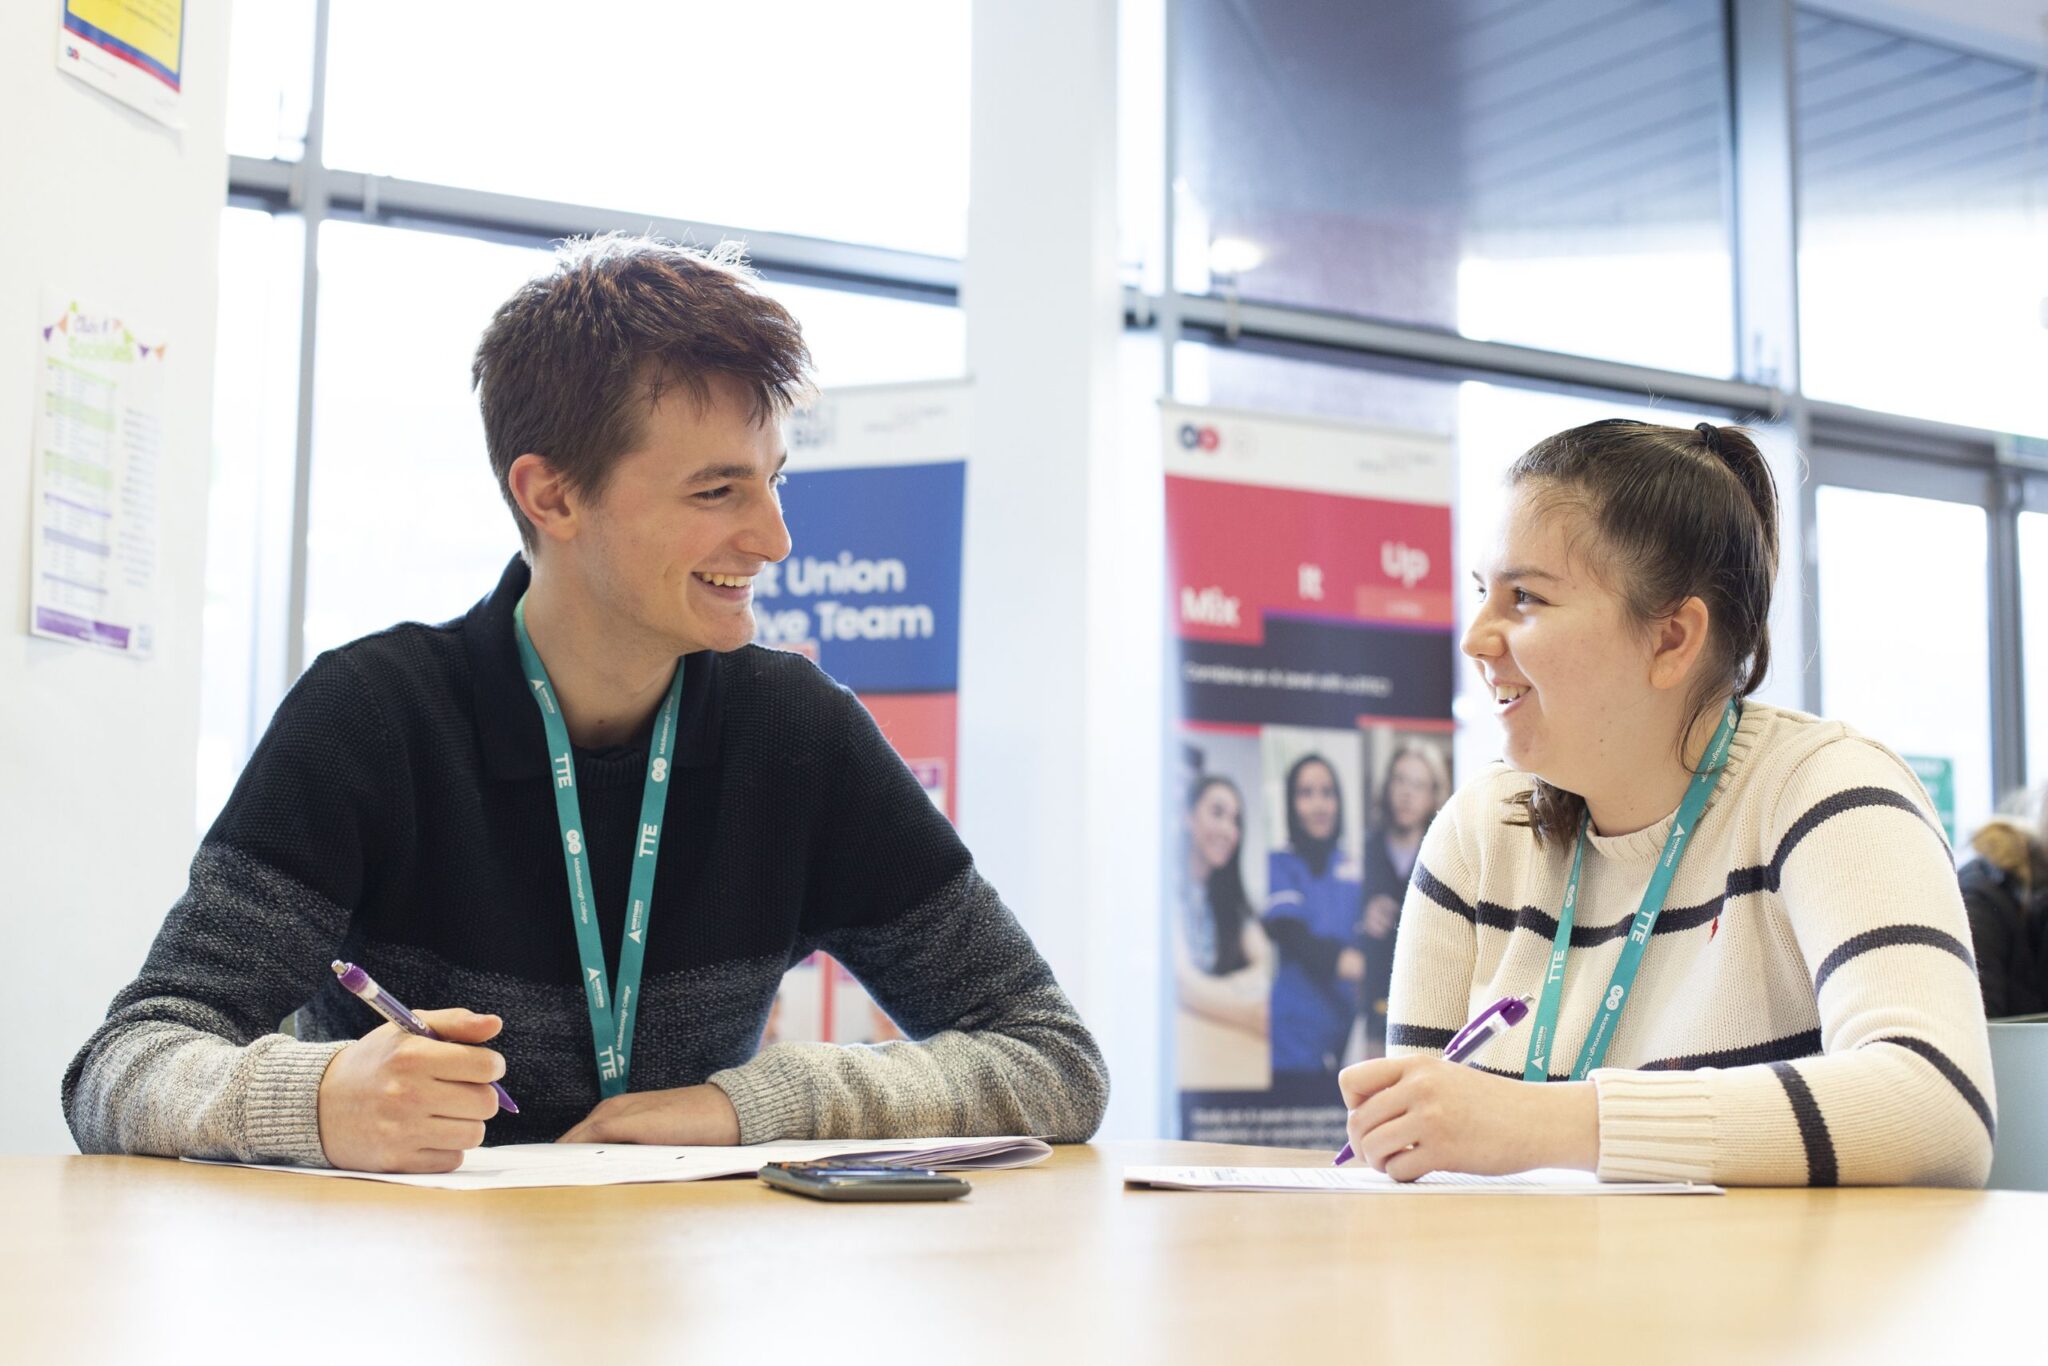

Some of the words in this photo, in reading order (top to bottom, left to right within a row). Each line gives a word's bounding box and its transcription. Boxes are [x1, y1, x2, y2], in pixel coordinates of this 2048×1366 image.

[787, 551, 906, 597] Union
[1181, 586, 1241, 628] Mix
[1298, 563, 1324, 601] It
[1380, 541, 1431, 588] Up
[815, 601, 934, 641] Team
[555, 752, 572, 789] TTE
[638, 823, 658, 857] TTE
[574, 857, 585, 901] Middlesbrough
[580, 901, 588, 925] College
[1631, 911, 1655, 945] TTE
[1548, 949, 1565, 984] TTE
[1589, 1013, 1610, 1057] Middlesbrough
[600, 1045, 617, 1081] TTE
